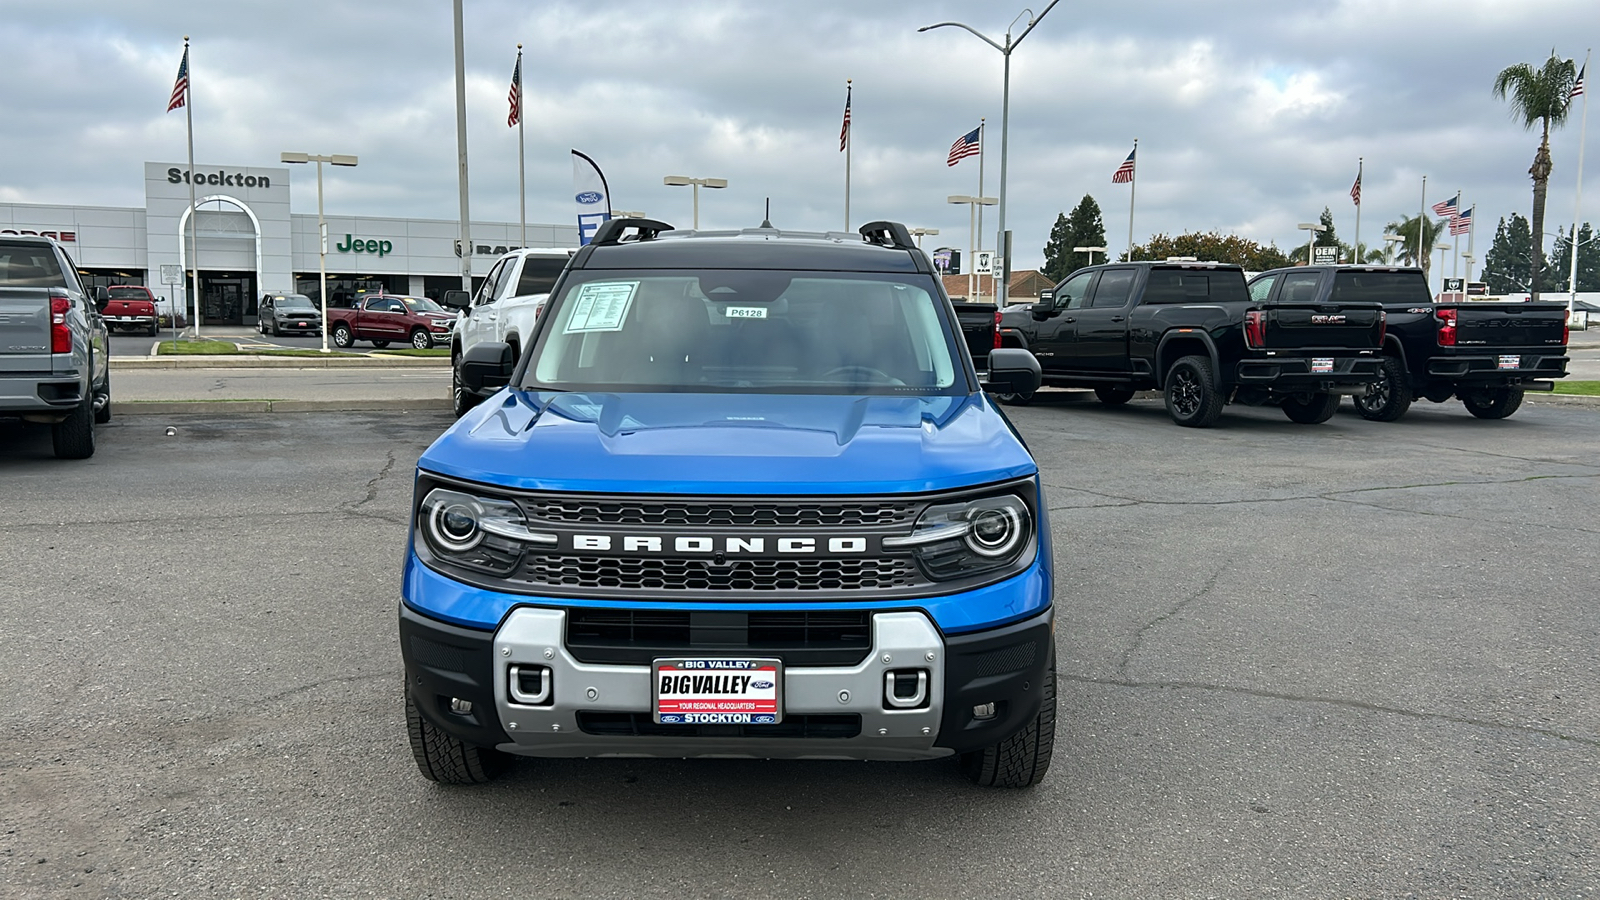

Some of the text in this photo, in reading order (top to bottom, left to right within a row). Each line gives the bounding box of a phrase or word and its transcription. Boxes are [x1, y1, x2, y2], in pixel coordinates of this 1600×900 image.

[168, 168, 270, 188] Stockton
[336, 234, 392, 258] Jeep
[476, 245, 529, 255] RA
[1315, 248, 1336, 256] OEM
[731, 309, 763, 317] P6128
[1312, 315, 1346, 323] GMC
[573, 534, 867, 553] BRONCO
[685, 661, 750, 669] BIG VALLEY
[753, 681, 771, 689] Ford
[679, 702, 756, 710] YOUR REGIONAL HEADQUARTERS
[684, 713, 751, 723] STOCKTON
